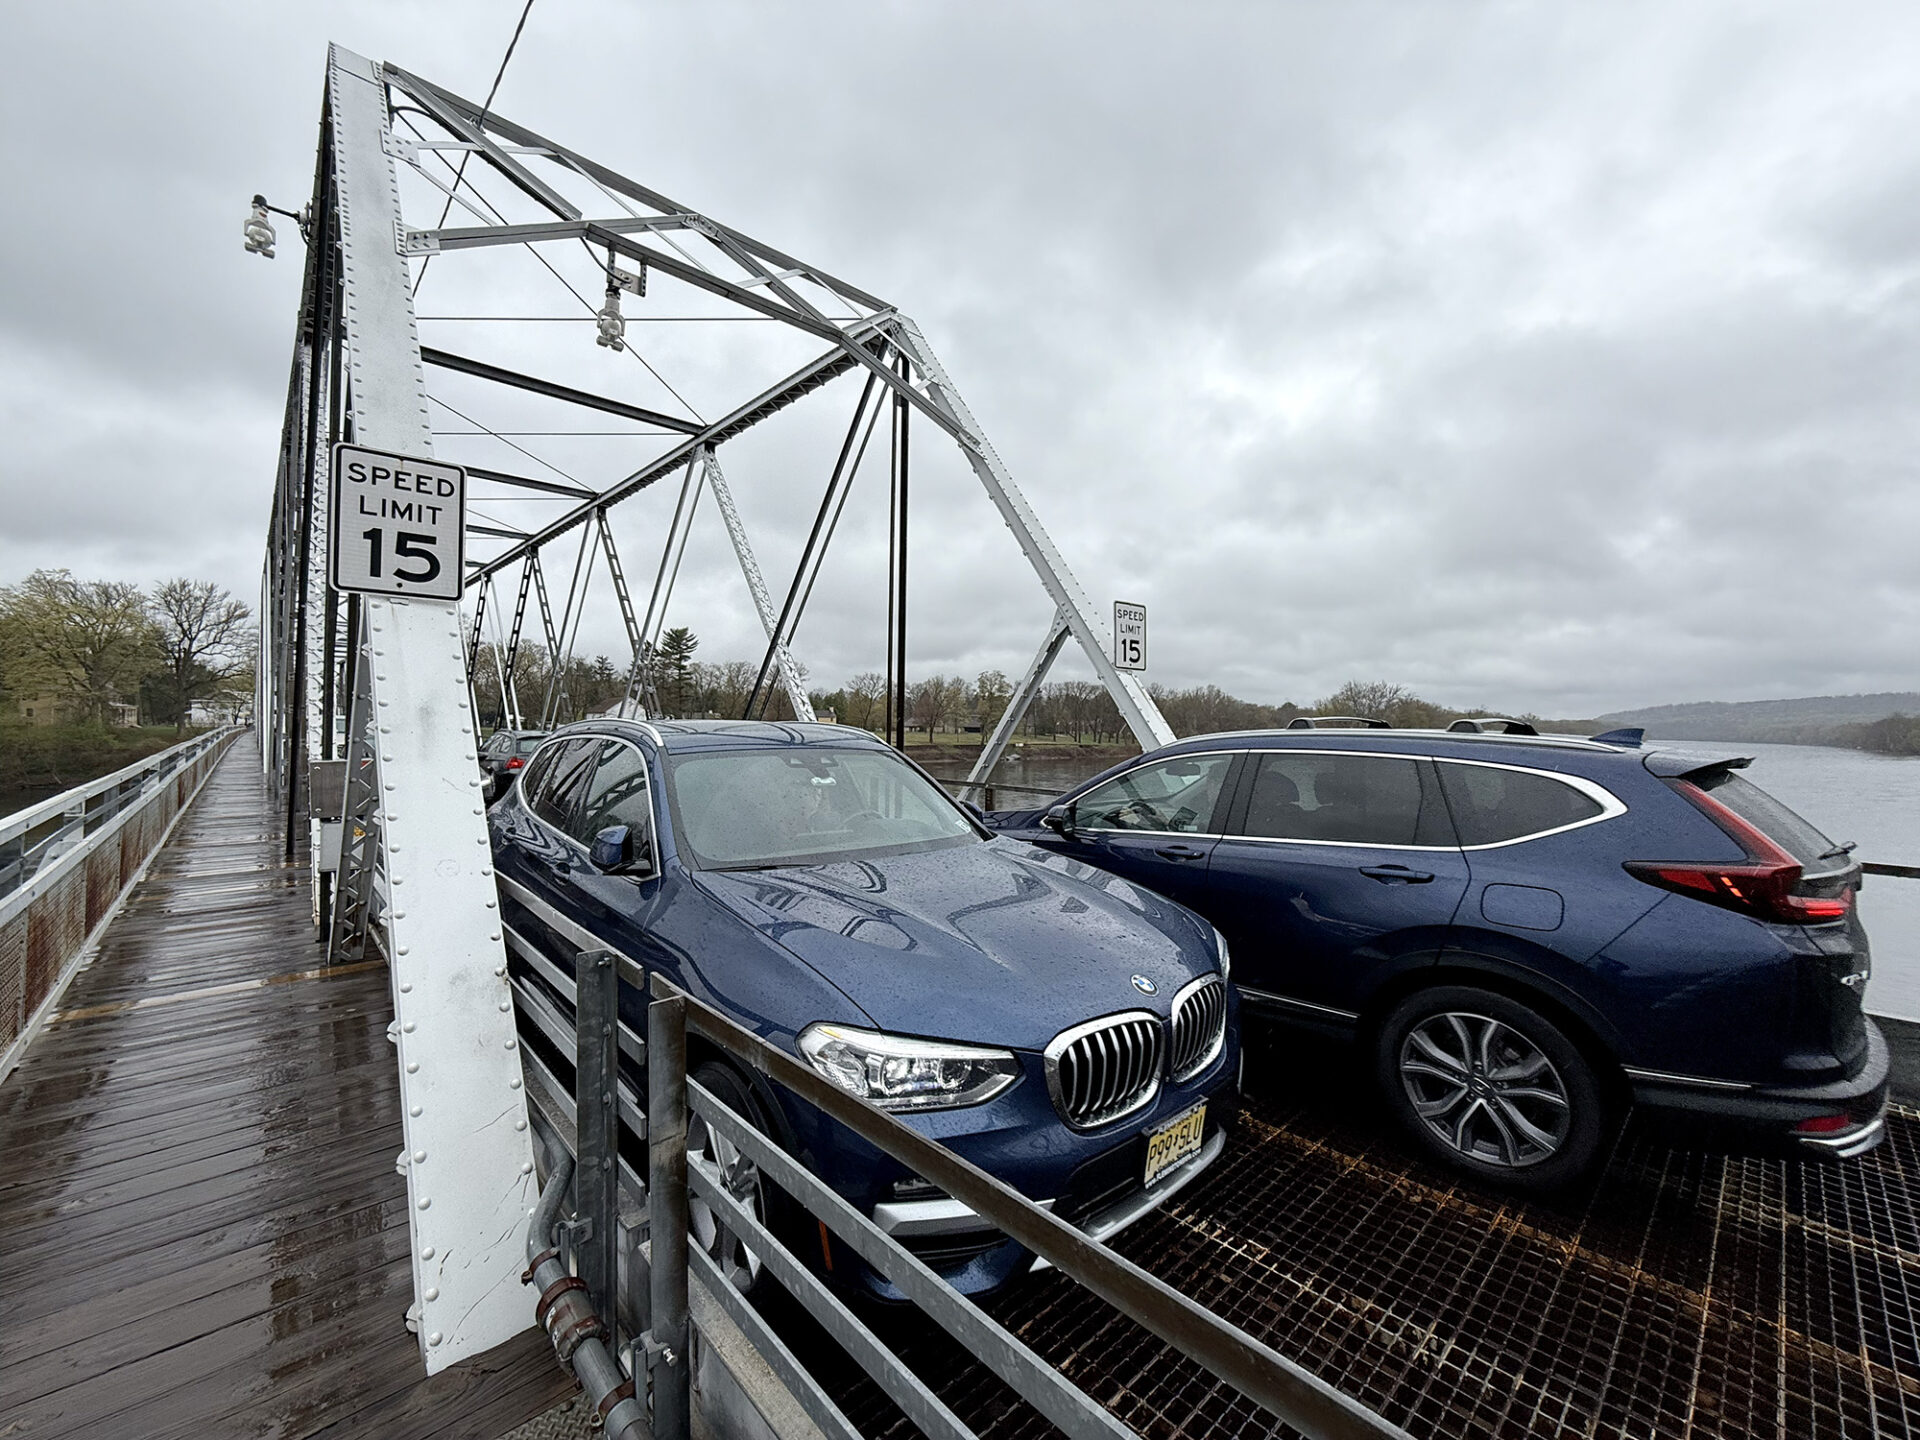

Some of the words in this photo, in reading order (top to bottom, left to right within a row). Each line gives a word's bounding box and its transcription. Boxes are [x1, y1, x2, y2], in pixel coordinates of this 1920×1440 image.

[347, 463, 455, 497] SPEED
[360, 495, 442, 525] LIMIT
[363, 527, 441, 583] 15
[1117, 609, 1144, 622] SPEED
[1120, 623, 1141, 635] LIMIT
[1121, 638, 1141, 663] 15
